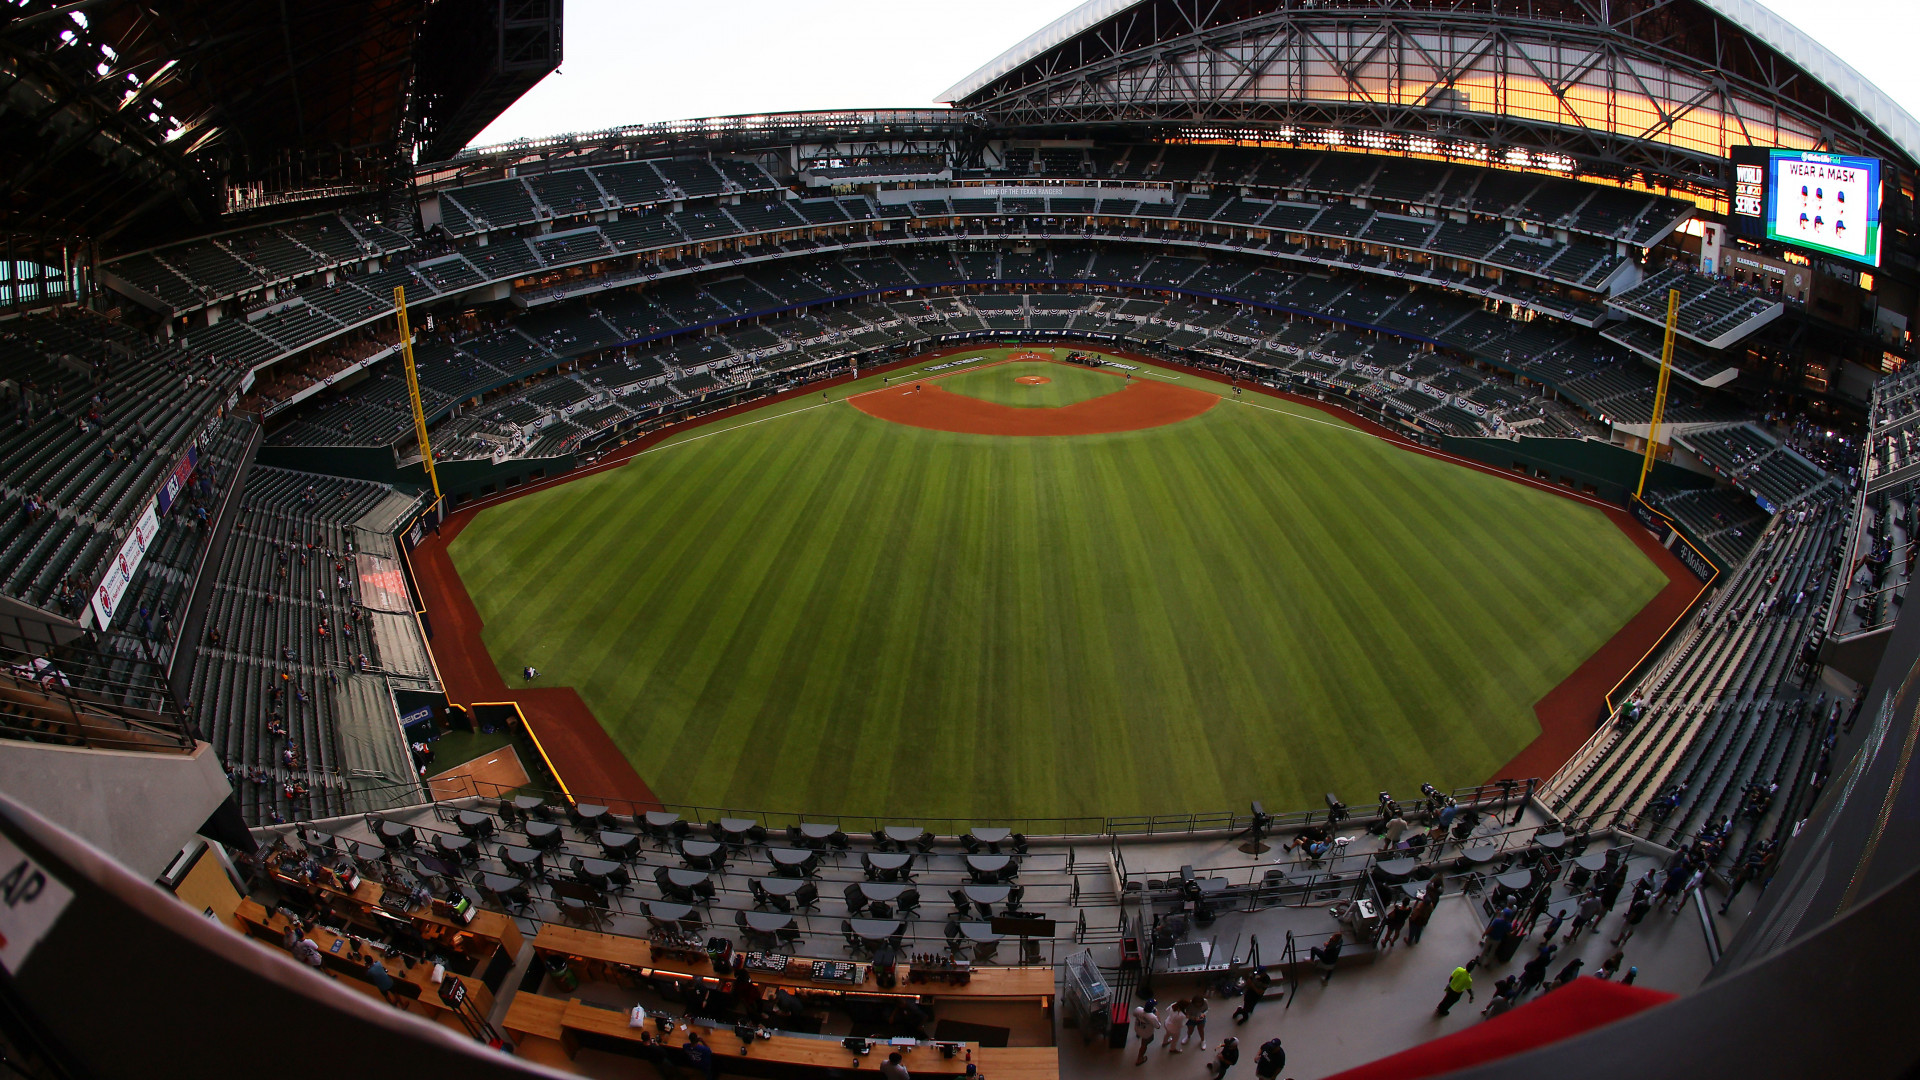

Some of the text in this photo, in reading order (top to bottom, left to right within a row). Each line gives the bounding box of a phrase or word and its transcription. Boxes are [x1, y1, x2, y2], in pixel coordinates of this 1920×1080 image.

[1737, 167, 1762, 184] WORLD
[1790, 164, 1854, 183] WEAR A MASK
[983, 188, 999, 196] HOME
[1735, 196, 1761, 214] SERIES
[0, 859, 46, 909] AP
